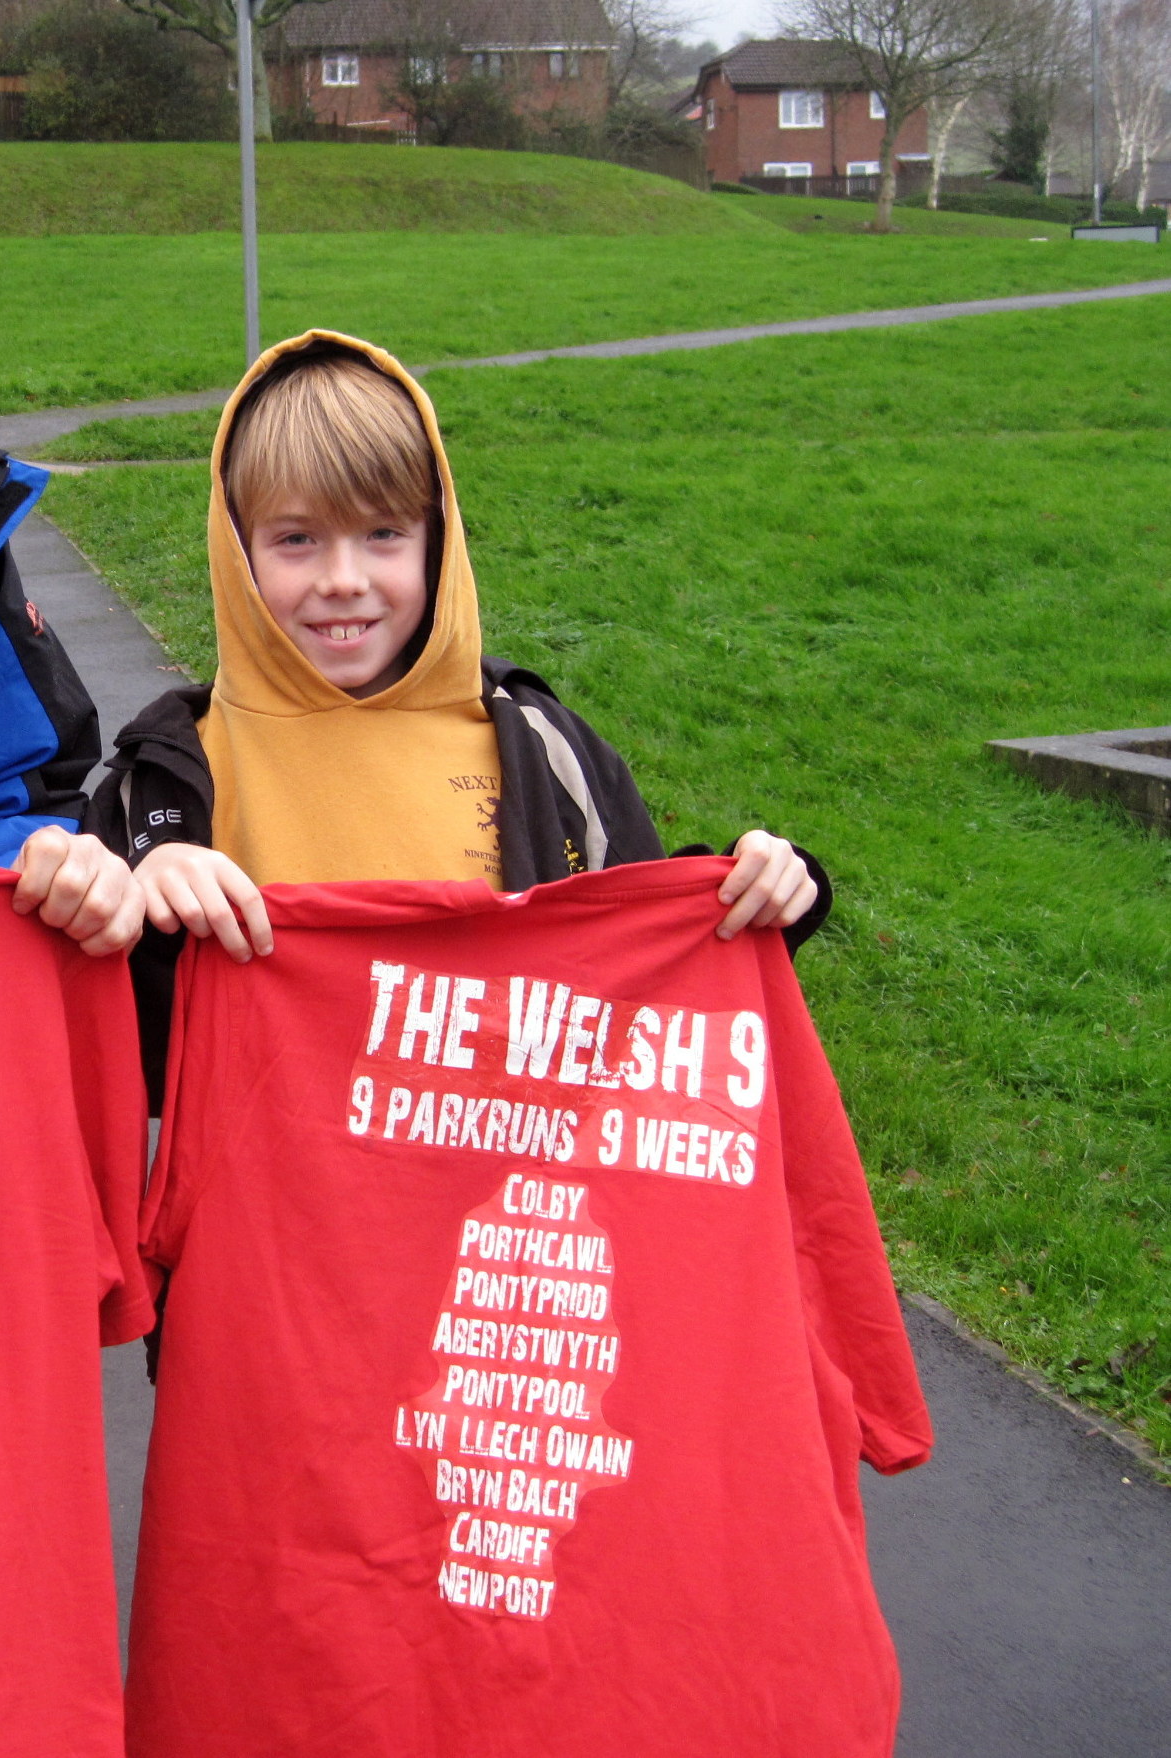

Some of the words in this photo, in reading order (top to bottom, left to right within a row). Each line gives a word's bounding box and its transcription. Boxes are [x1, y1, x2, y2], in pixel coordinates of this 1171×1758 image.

[448, 775, 497, 792] NEXT
[366, 960, 486, 1069] THE
[504, 976, 706, 1098] WELSH
[727, 1010, 766, 1108] 9
[348, 1075, 374, 1136] 9
[383, 1086, 578, 1162] PARKRUNS
[598, 1108, 624, 1166] 9
[636, 1116, 758, 1185] WEEKS
[503, 1173, 584, 1221] COLBY
[459, 1219, 612, 1274] PORTHCAWL
[453, 1267, 608, 1321] PONTYPRIDD
[431, 1312, 618, 1374] ABERYSTWYTH
[443, 1364, 589, 1420] PONTYPOOL
[395, 1405, 446, 1451] LYN
[459, 1416, 538, 1463] LLECH
[545, 1424, 632, 1478] OWAIN
[435, 1458, 502, 1510] BRYN
[506, 1469, 577, 1520] BACH
[449, 1511, 550, 1565] CARDIFF
[437, 1560, 555, 1617] NEWPORT
